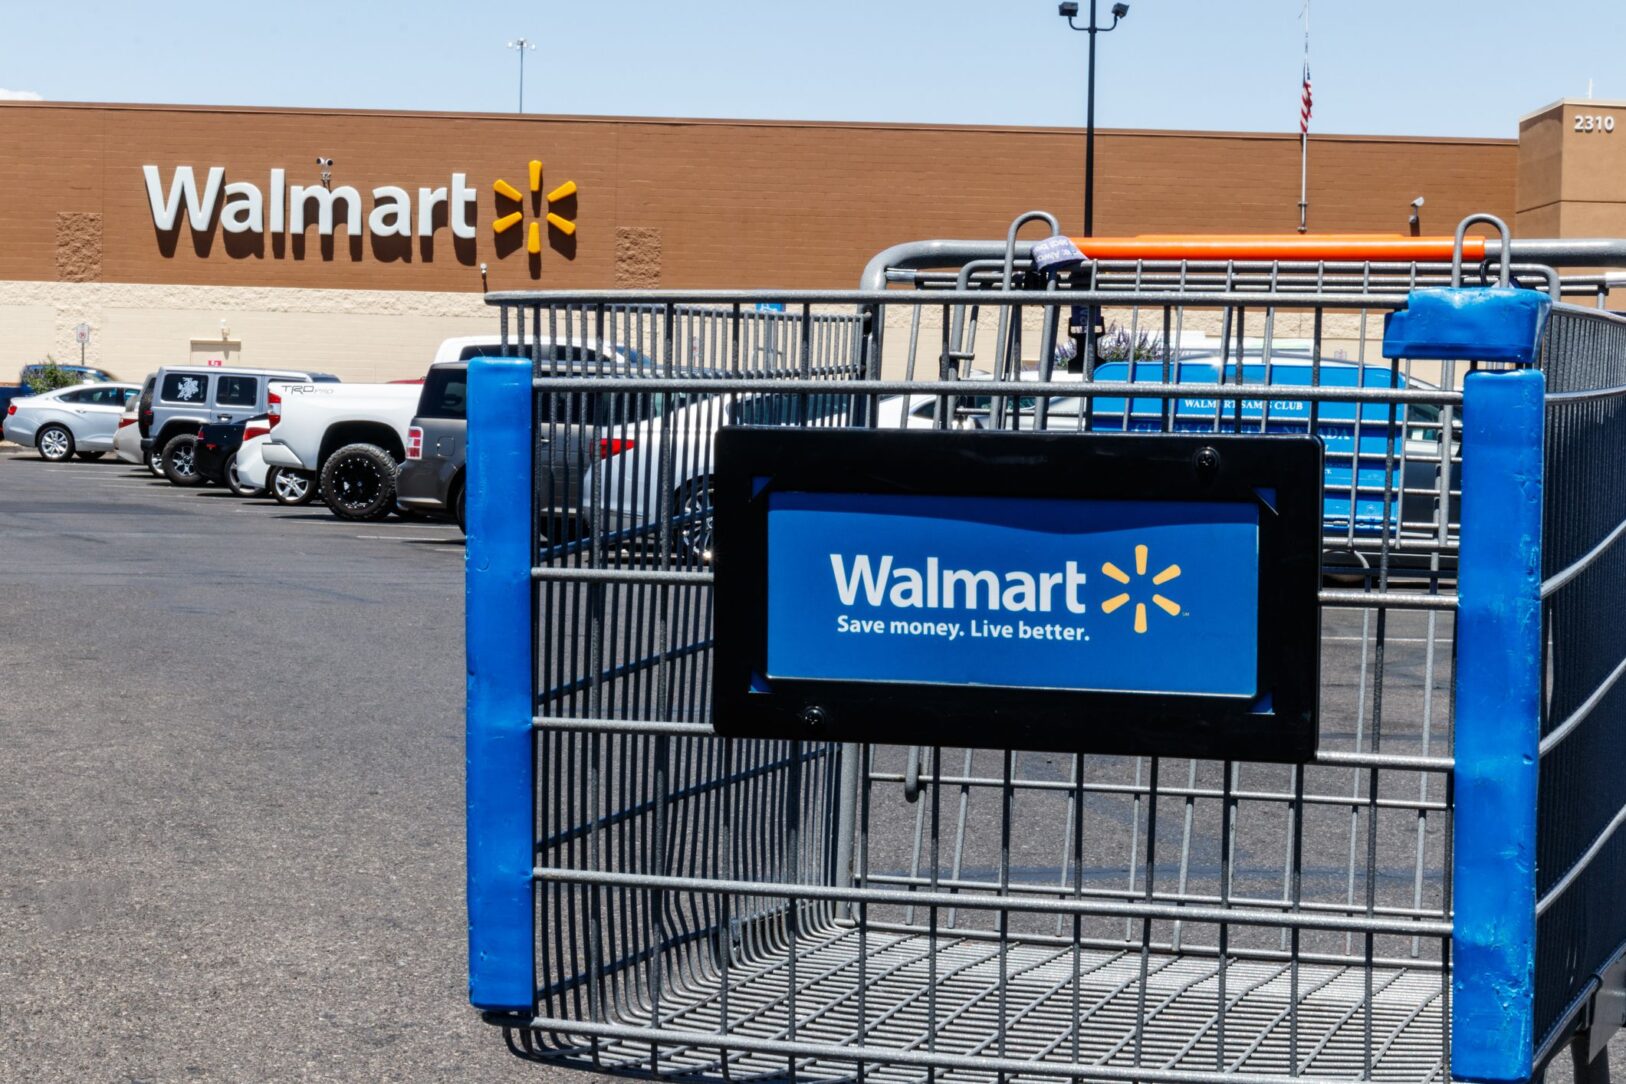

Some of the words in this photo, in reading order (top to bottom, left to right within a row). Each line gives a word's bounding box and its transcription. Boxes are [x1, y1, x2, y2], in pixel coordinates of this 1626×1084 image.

[1574, 115, 1614, 130] 2310
[142, 165, 477, 239] Walmart
[281, 385, 314, 394] TRD
[1184, 399, 1236, 409] WALMRT
[1274, 401, 1303, 410] CLUB
[830, 553, 1086, 614] Walmart
[837, 615, 885, 634] Save
[890, 620, 965, 640] money.
[971, 619, 1013, 638] Live
[1018, 620, 1090, 641] better.
